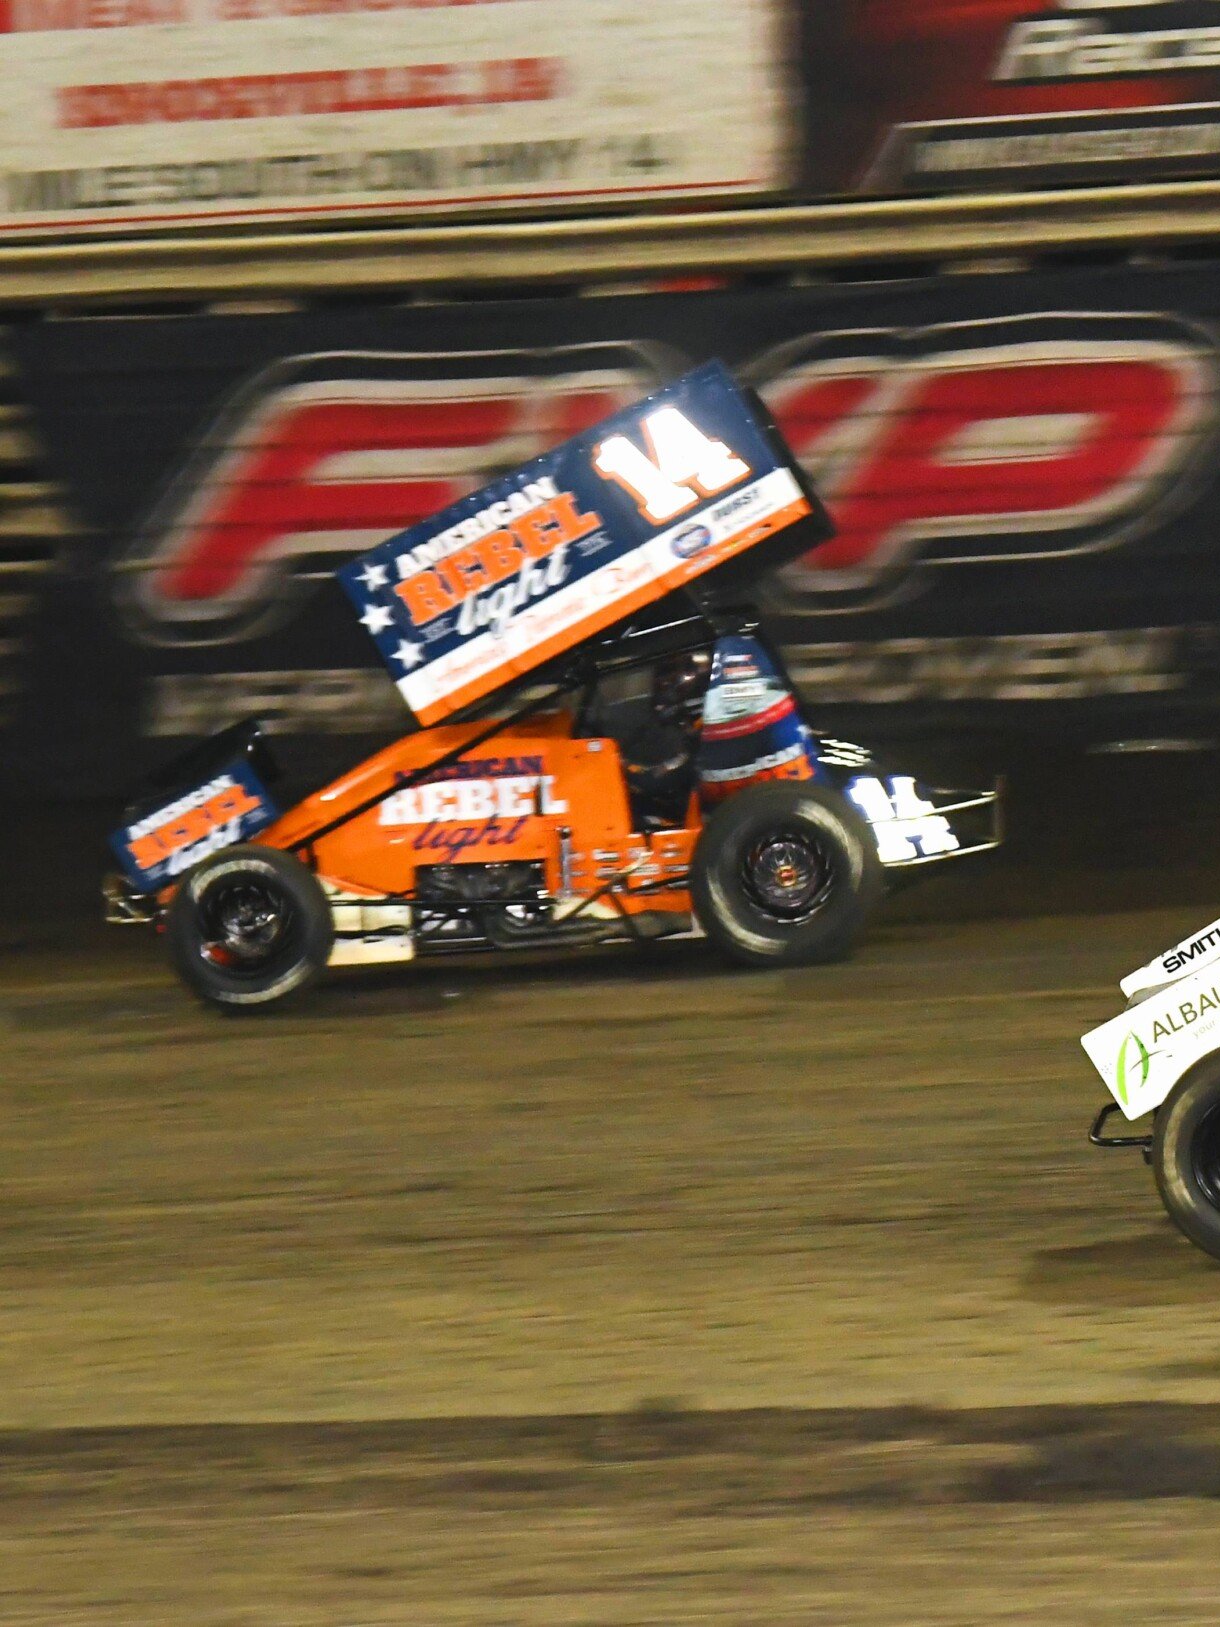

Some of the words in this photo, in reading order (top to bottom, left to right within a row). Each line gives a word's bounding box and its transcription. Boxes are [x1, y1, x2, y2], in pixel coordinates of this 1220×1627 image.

[592, 405, 753, 526] 14
[394, 490, 602, 627] REBEL
[395, 475, 556, 581] AMERICAN
[457, 545, 571, 640] light
[378, 775, 568, 826] REBEL
[1192, 1019, 1217, 1039] your
